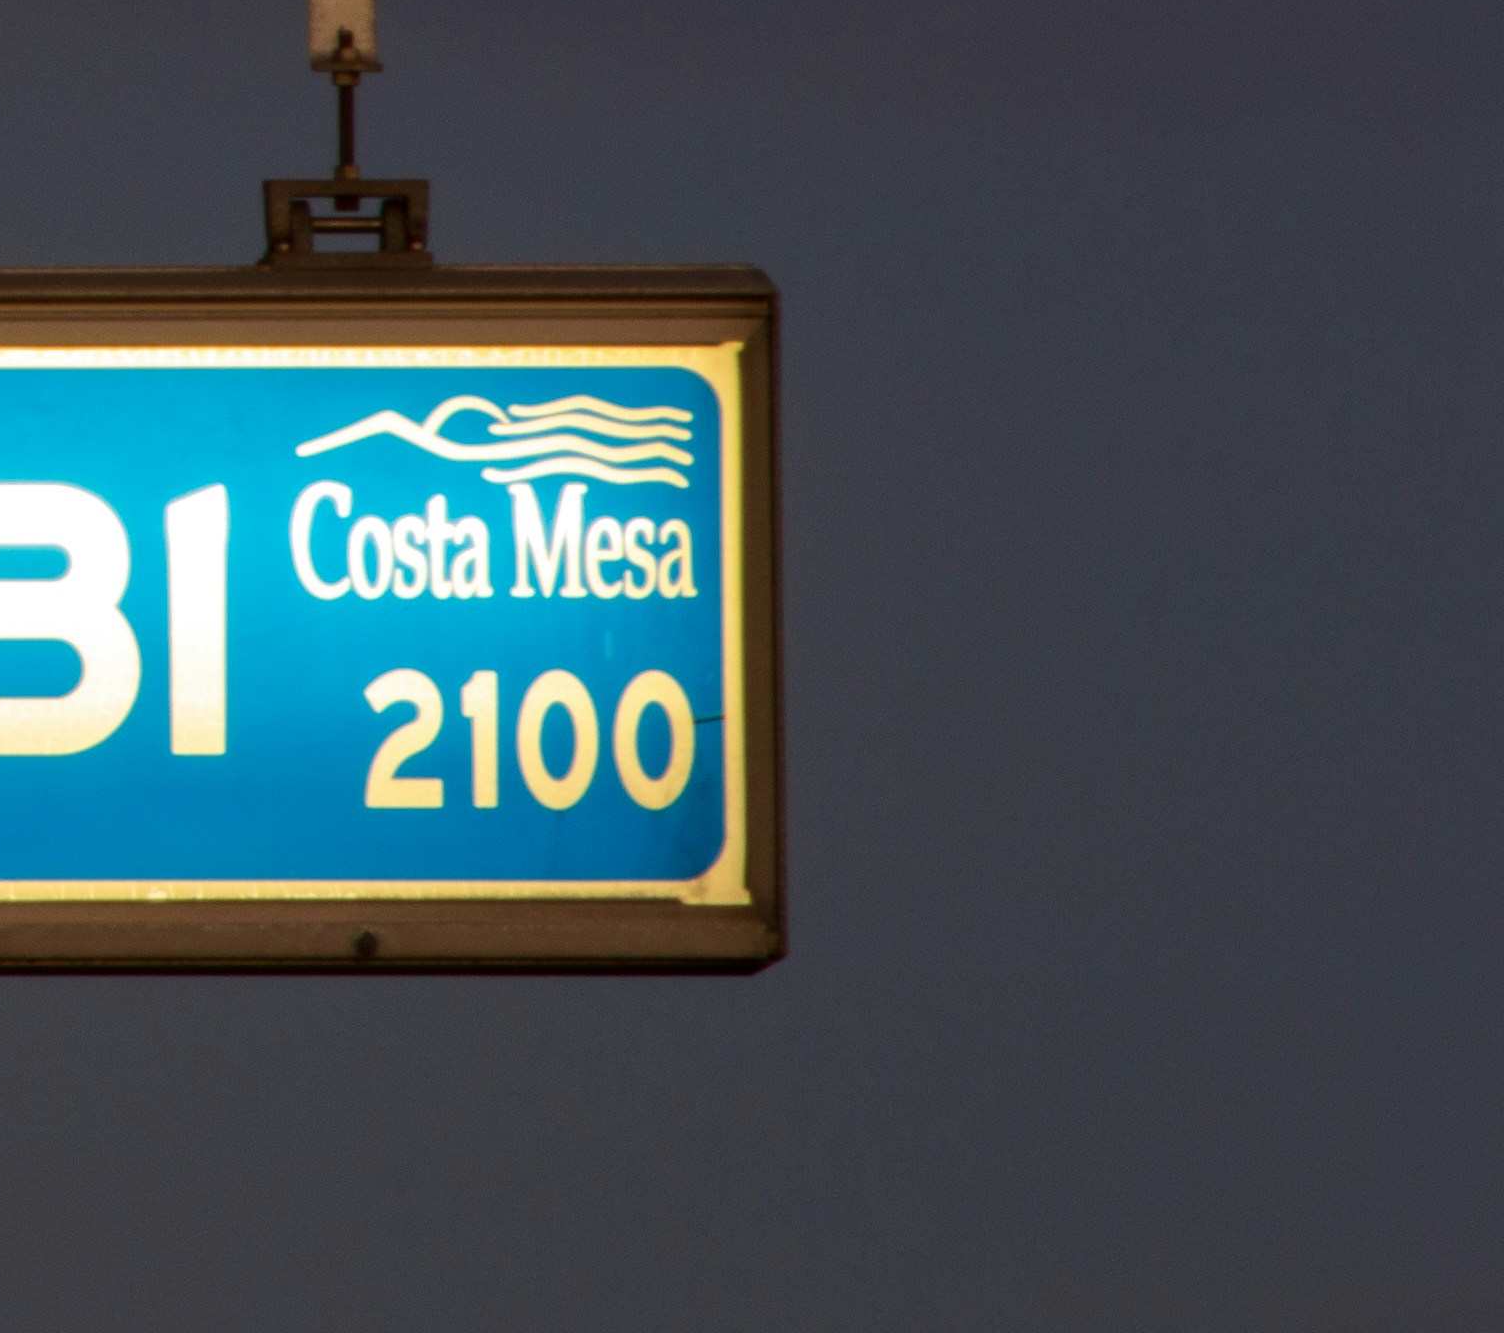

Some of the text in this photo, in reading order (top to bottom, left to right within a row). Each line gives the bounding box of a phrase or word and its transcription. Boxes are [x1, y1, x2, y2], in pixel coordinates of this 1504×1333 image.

[289, 480, 697, 600] Costa Mesa
[363, 668, 696, 810] 2100
